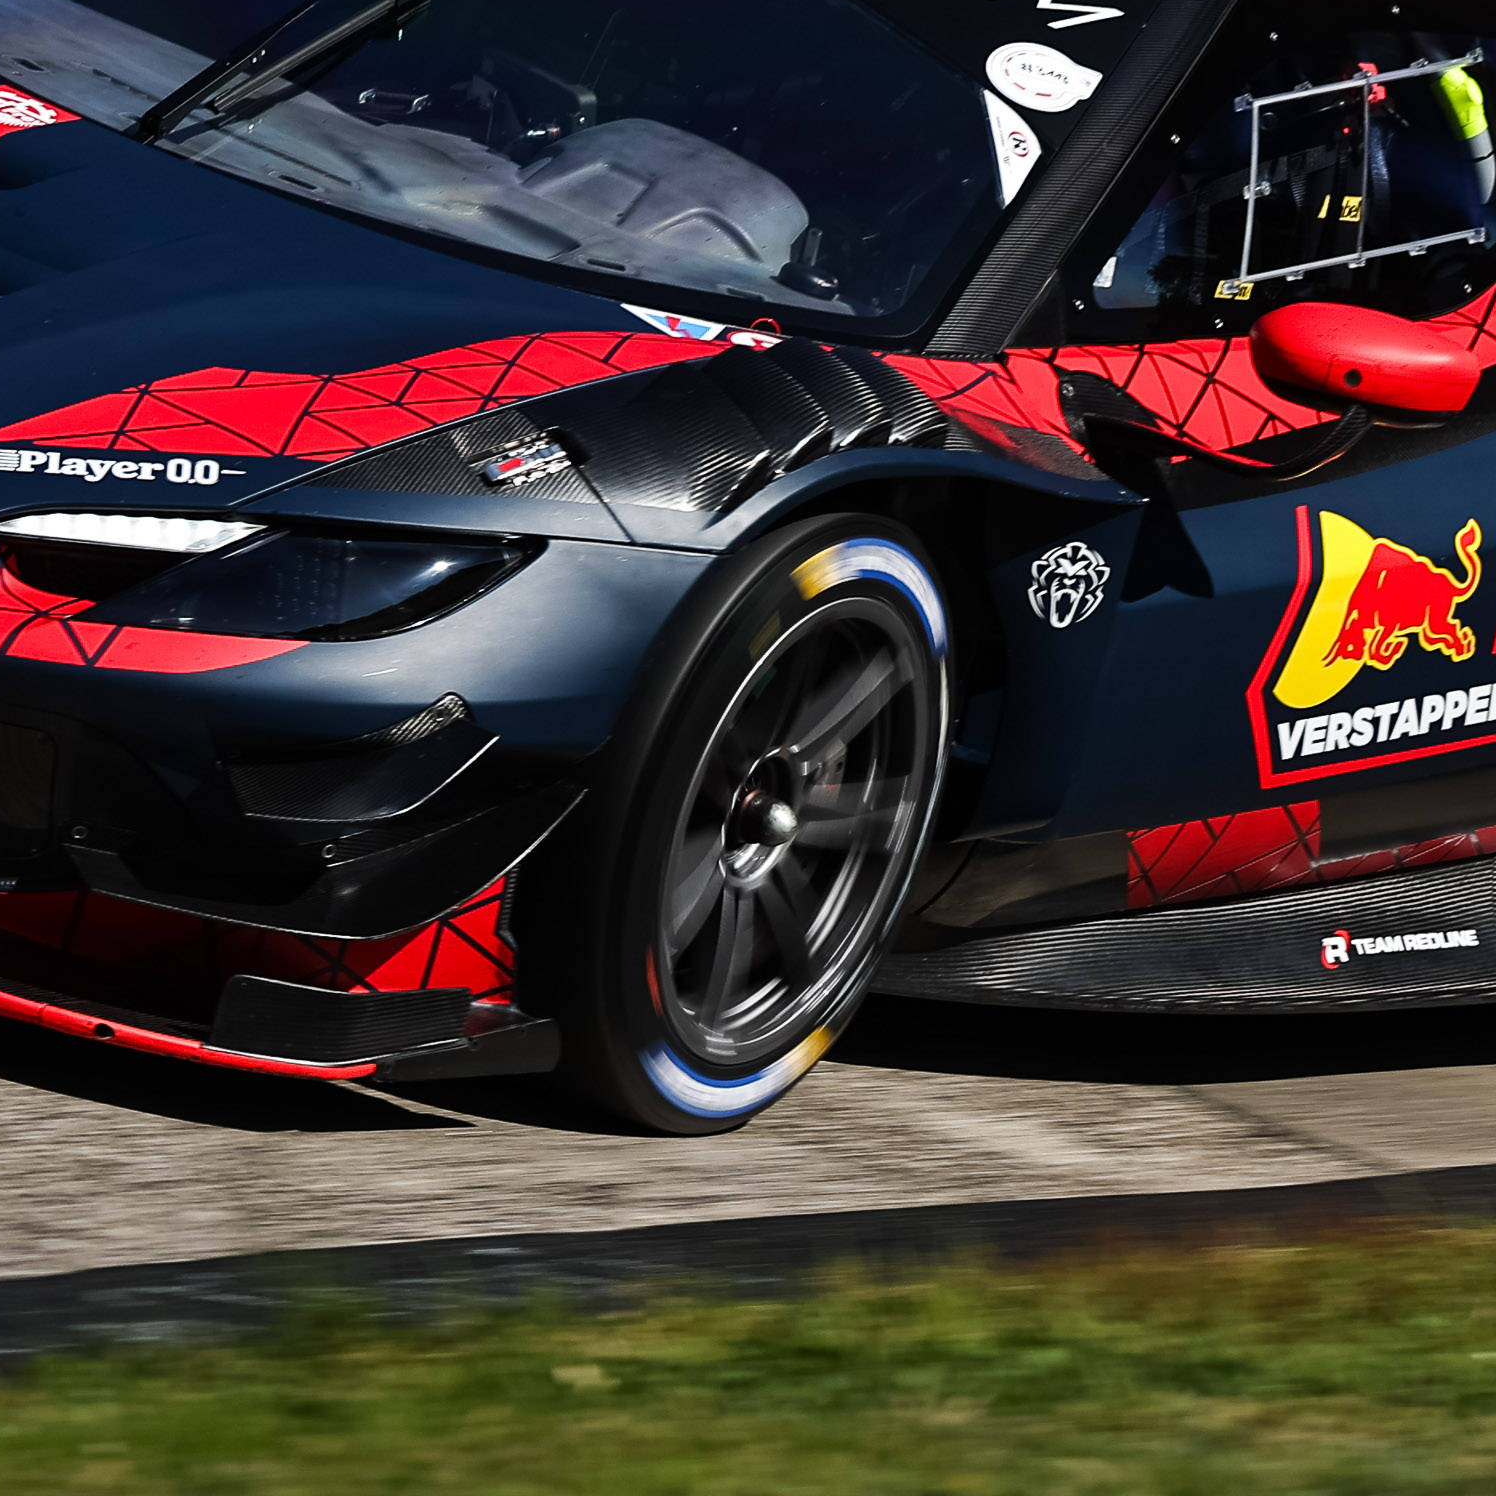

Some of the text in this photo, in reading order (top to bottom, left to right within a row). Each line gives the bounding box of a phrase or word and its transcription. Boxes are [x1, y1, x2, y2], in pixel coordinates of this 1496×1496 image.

[15, 449, 165, 483] Player
[1350, 928, 1480, 955] TEAM REDLINE
